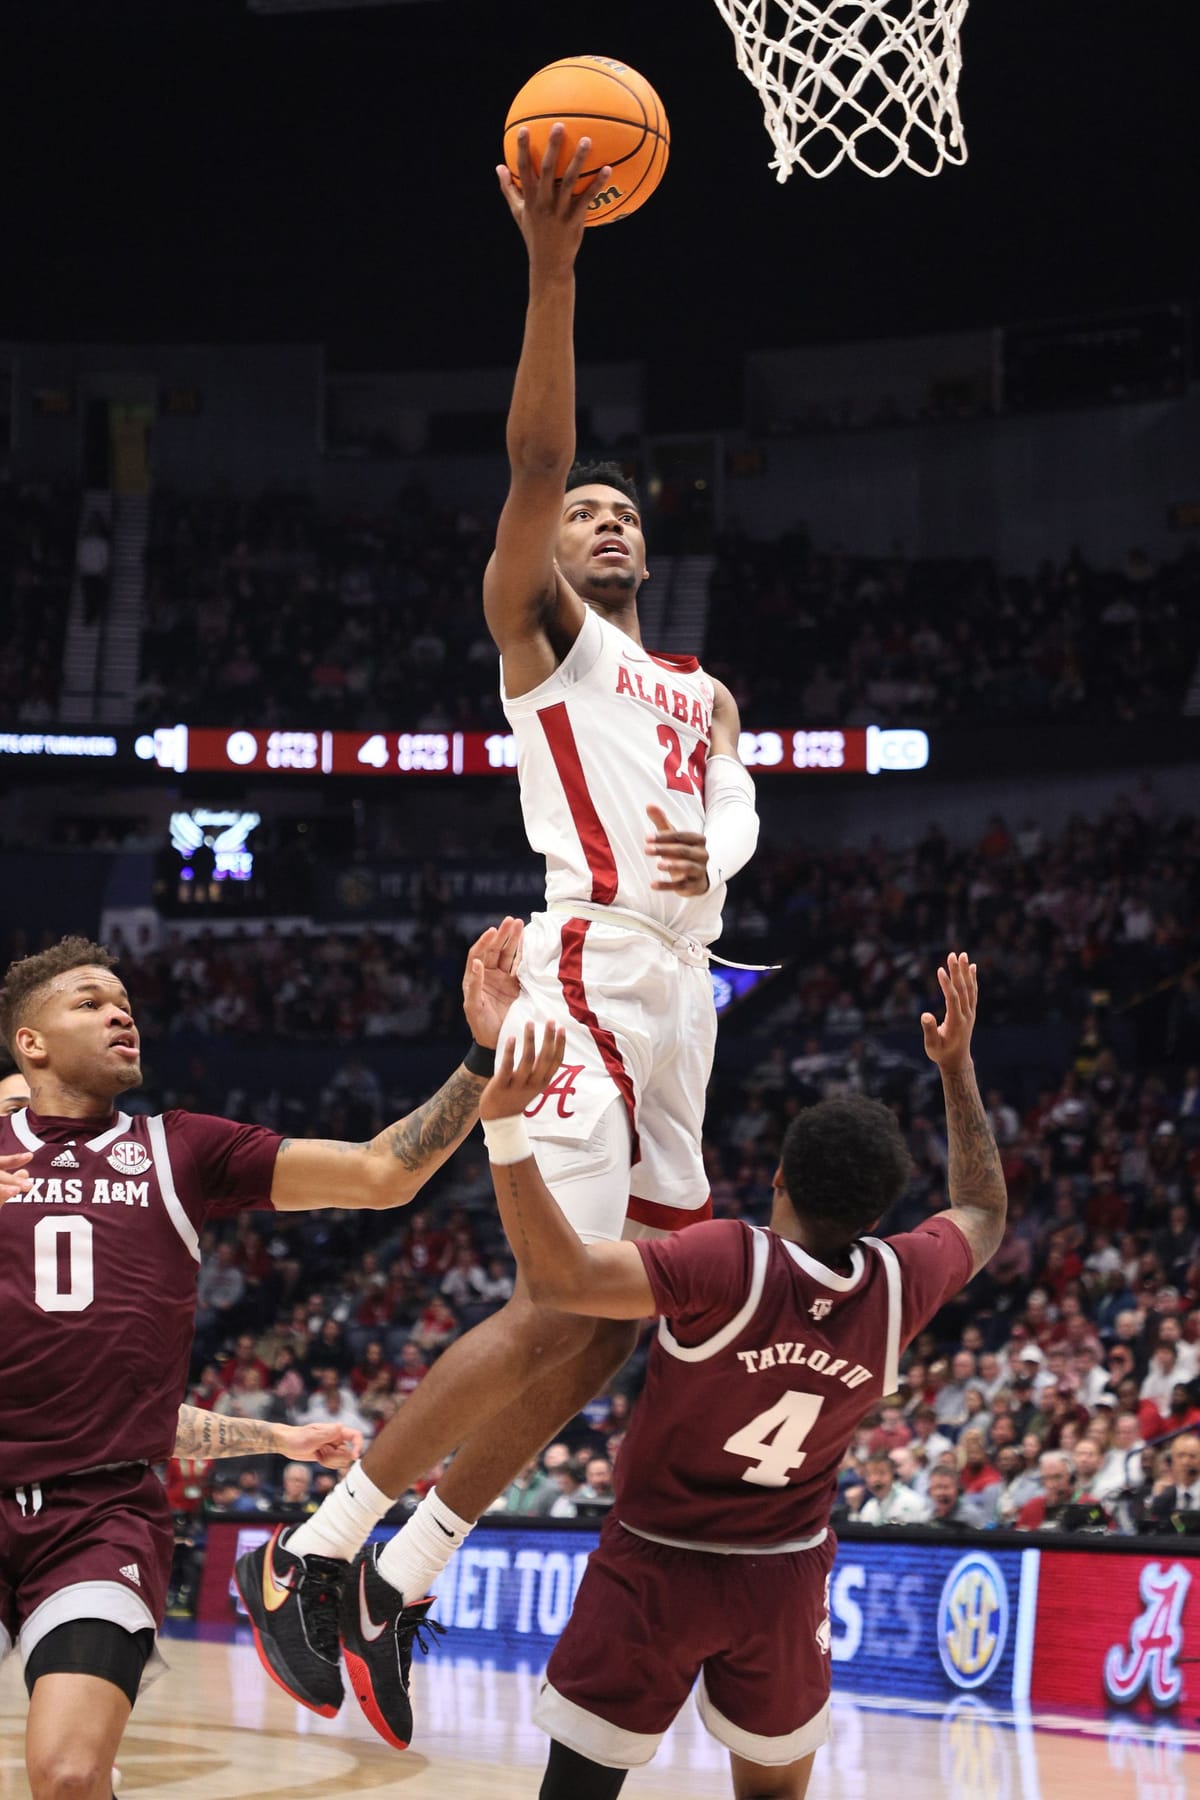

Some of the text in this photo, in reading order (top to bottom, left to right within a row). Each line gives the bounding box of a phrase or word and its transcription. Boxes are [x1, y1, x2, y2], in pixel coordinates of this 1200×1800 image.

[616, 666, 711, 739] ALABA
[357, 735, 389, 768] 4
[523, 1063, 586, 1118] A
[51, 1160, 80, 1168] adidas
[114, 1142, 146, 1166] SEC
[92, 1179, 149, 1207] A&M
[34, 1215, 94, 1312] 0
[737, 1342, 848, 1376] TAYLOR
[723, 1390, 825, 1488] 4
[1106, 1562, 1191, 1700] A
